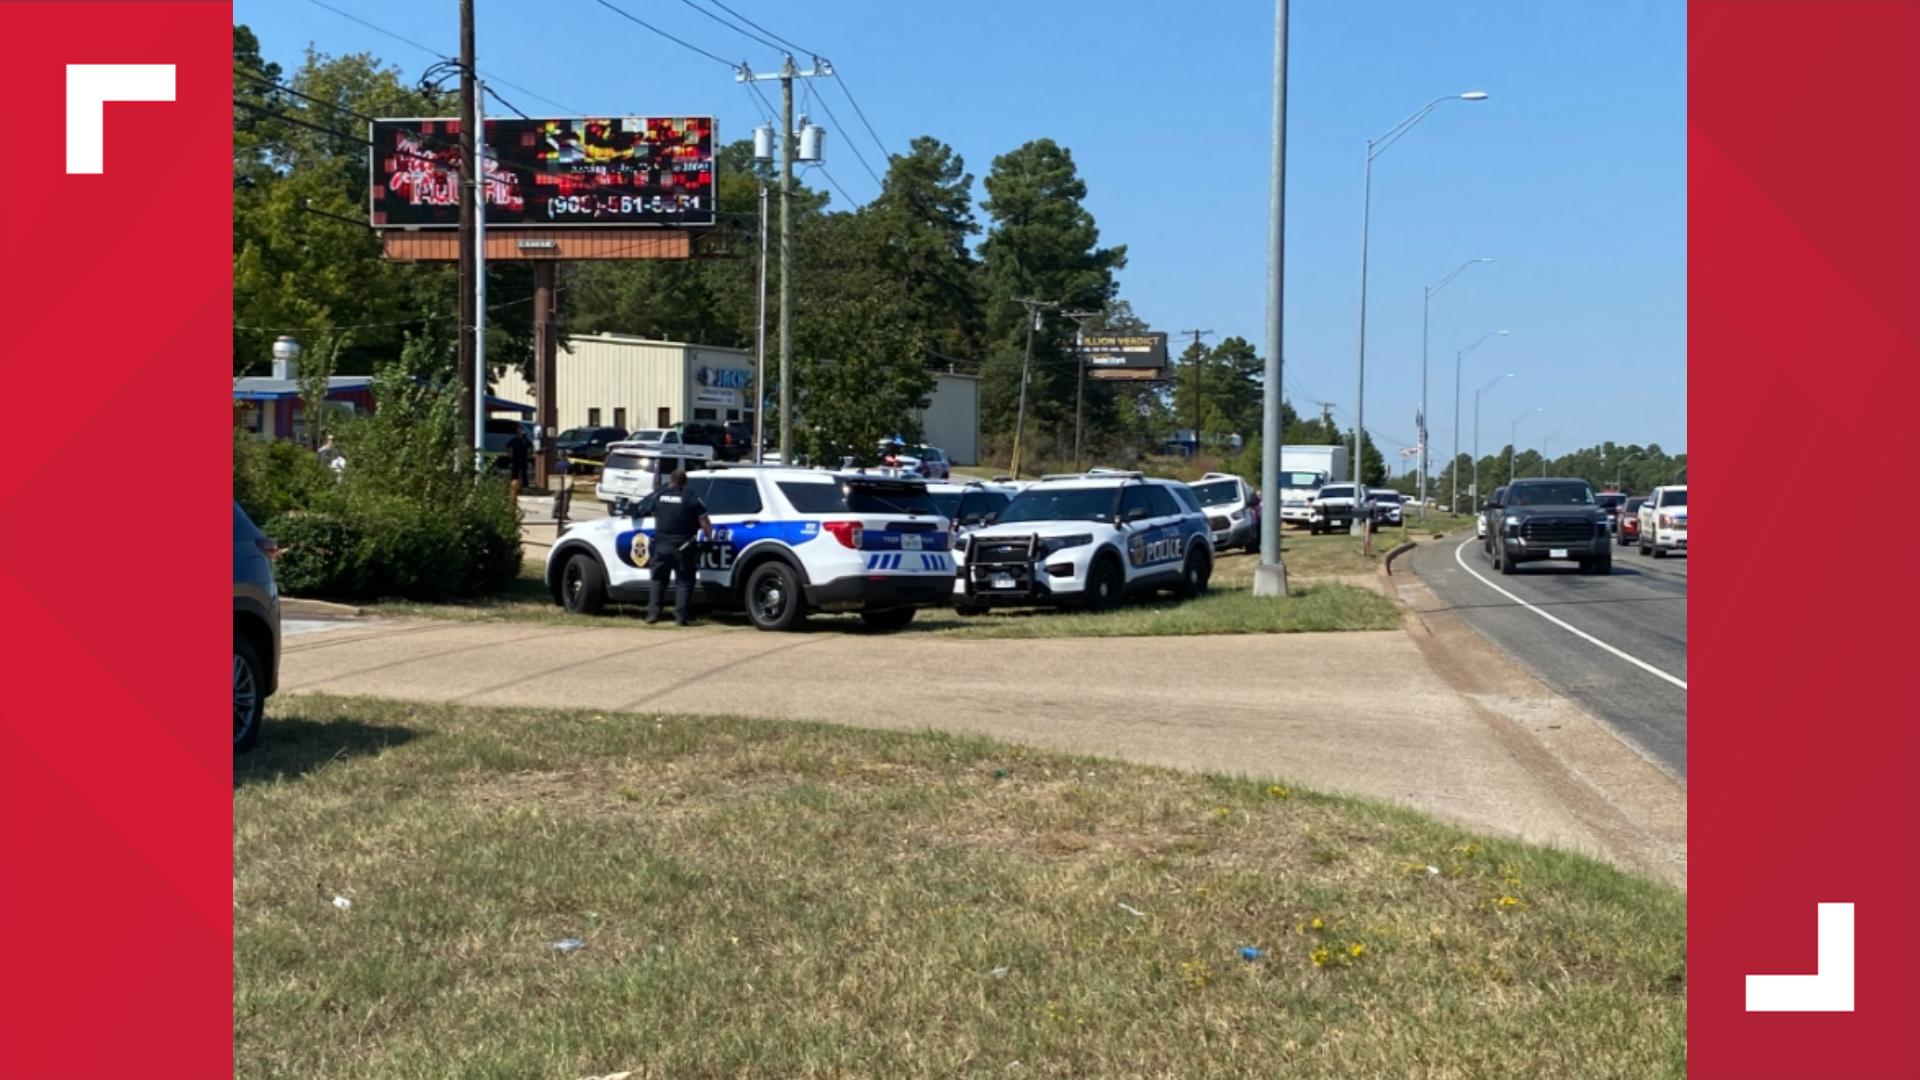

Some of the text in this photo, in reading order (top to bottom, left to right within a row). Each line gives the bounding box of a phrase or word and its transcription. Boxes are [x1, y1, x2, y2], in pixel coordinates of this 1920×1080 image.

[1084, 336, 1116, 346] ILLION
[698, 545, 732, 569] ICE
[1146, 538, 1182, 562] POLICE
